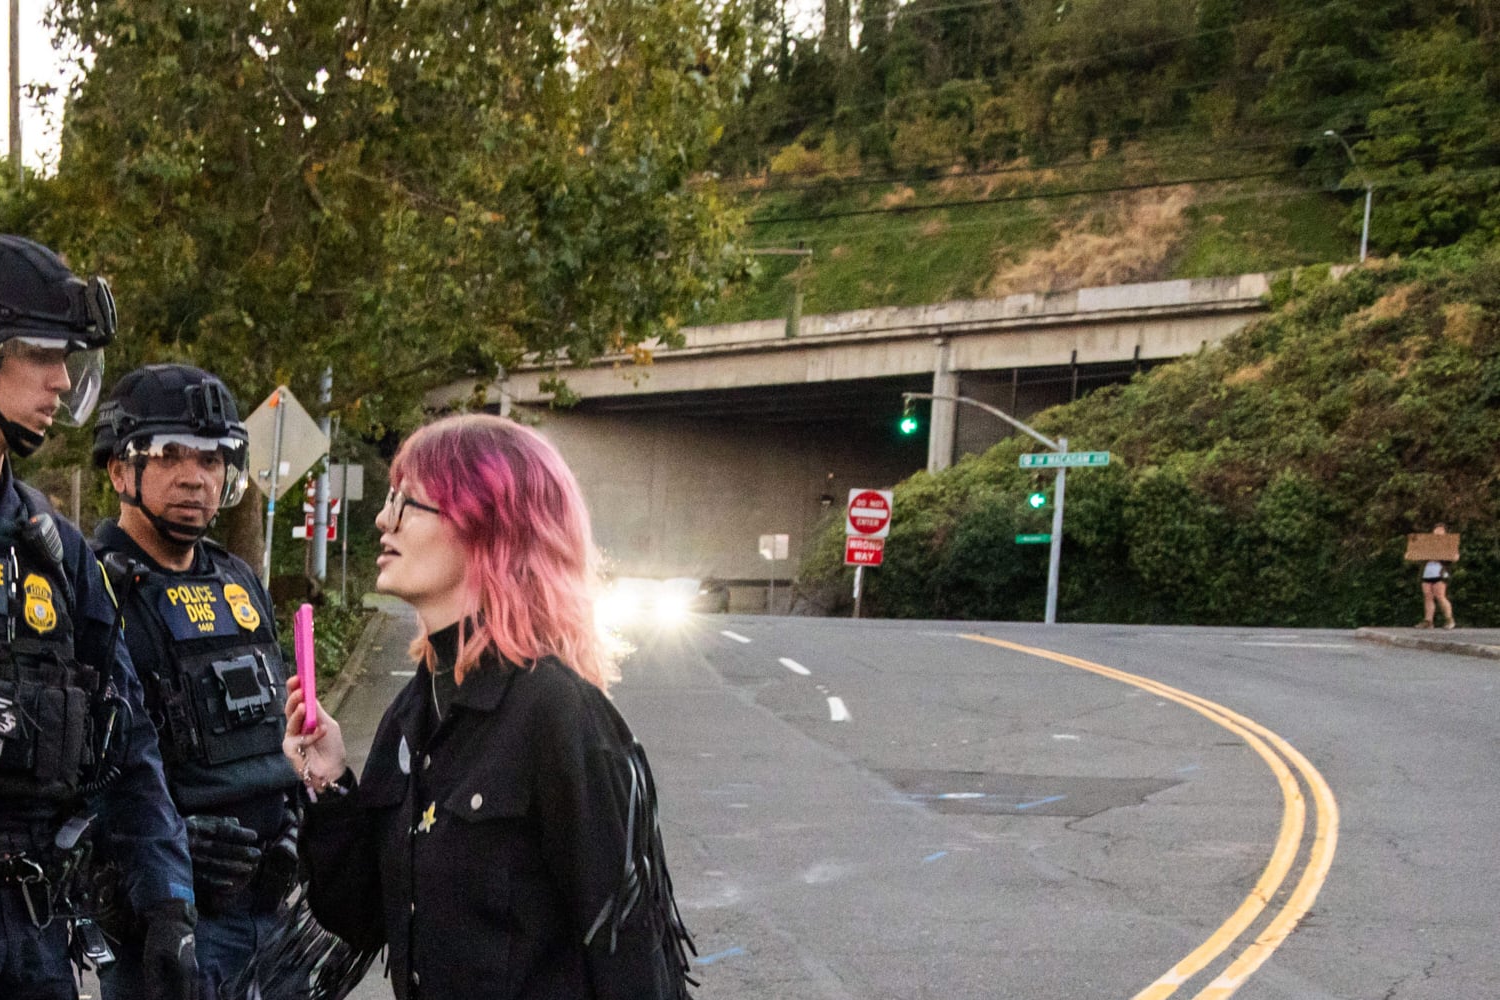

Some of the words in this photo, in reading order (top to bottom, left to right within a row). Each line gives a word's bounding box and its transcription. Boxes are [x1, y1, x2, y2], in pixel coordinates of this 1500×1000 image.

[849, 540, 882, 551] WRONG
[854, 551, 875, 562] WAY
[166, 585, 217, 606] POLICE
[185, 603, 216, 623] DHS
